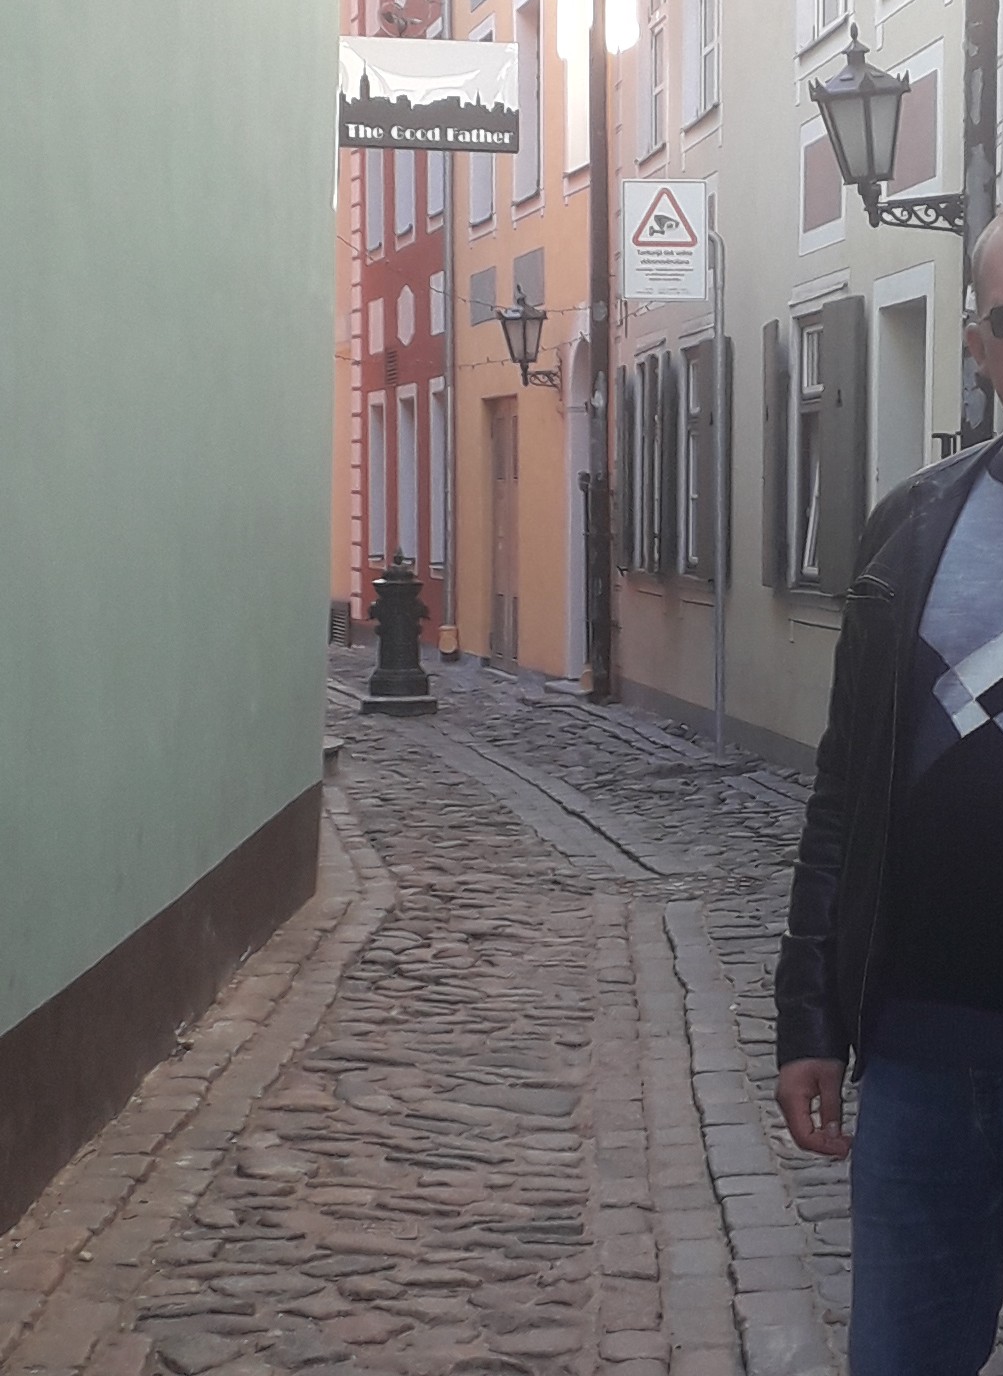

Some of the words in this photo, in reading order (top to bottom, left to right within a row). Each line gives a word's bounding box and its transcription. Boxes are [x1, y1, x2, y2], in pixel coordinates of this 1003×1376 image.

[346, 123, 384, 139] The
[390, 125, 440, 142] Good
[446, 127, 513, 144] Father
